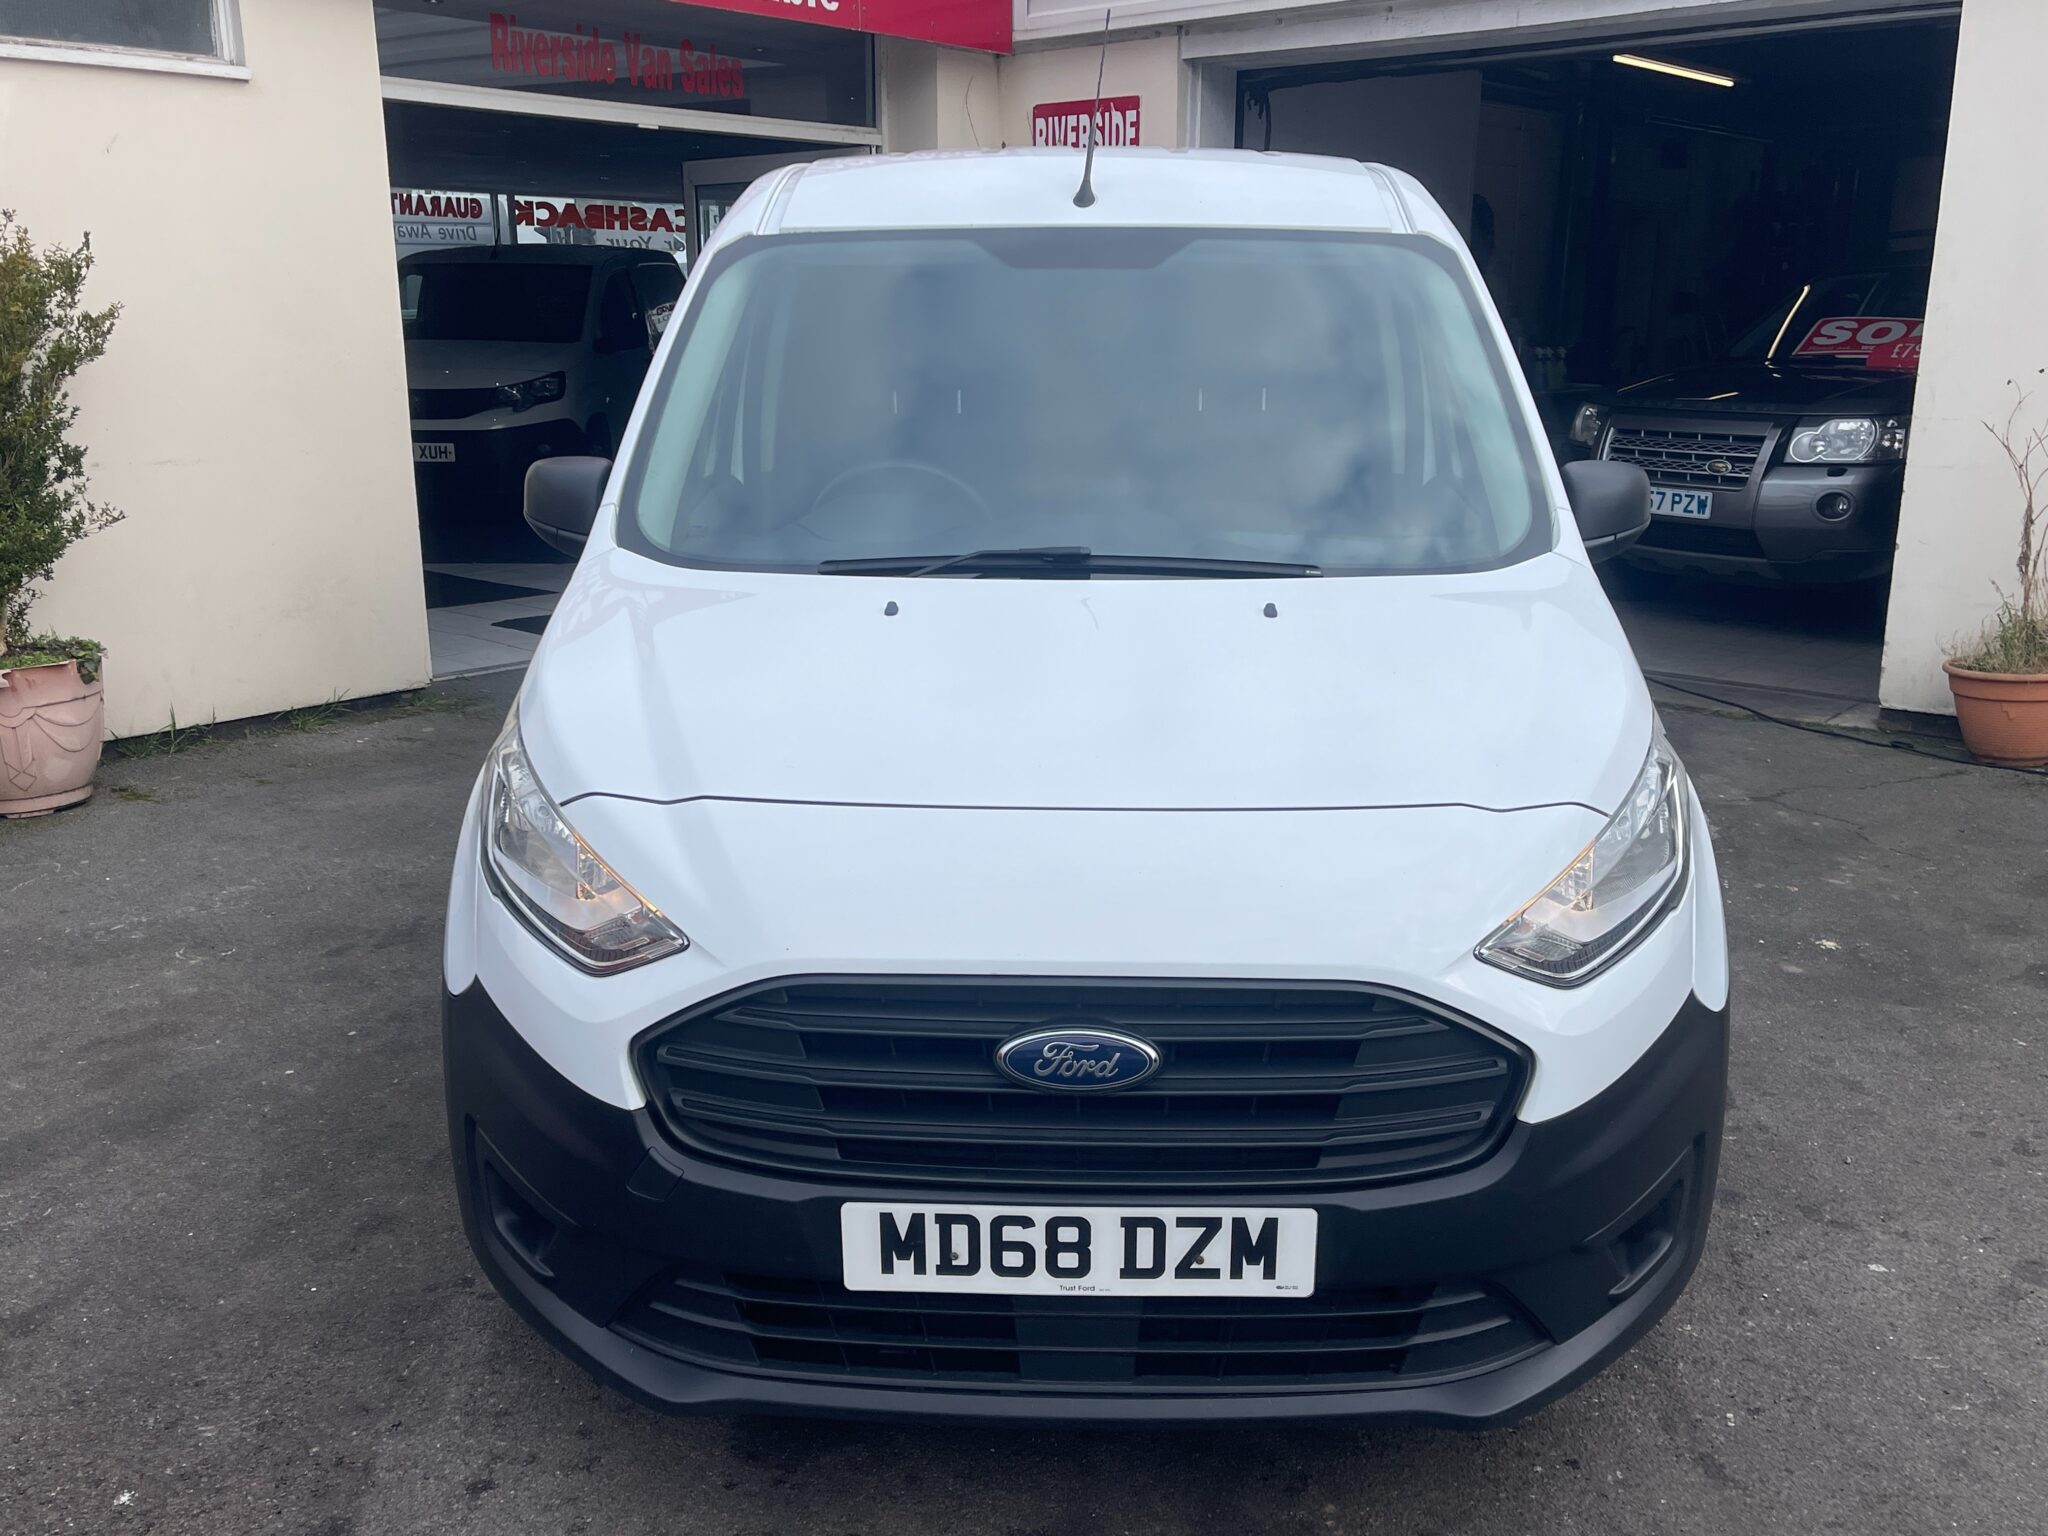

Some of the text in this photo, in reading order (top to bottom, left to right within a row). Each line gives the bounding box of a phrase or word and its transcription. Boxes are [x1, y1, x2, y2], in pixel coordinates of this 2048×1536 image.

[490, 12, 745, 98] Riverside Van Sales
[1035, 109, 1137, 147] RIVERSIDE
[419, 445, 449, 460] XUH
[1670, 493, 1709, 515] PZW
[1033, 1041, 1121, 1078] Ford
[879, 1211, 1279, 1280] MD68 DZM
[1060, 1284, 1076, 1292] Trust
[1078, 1284, 1095, 1292] Ford
